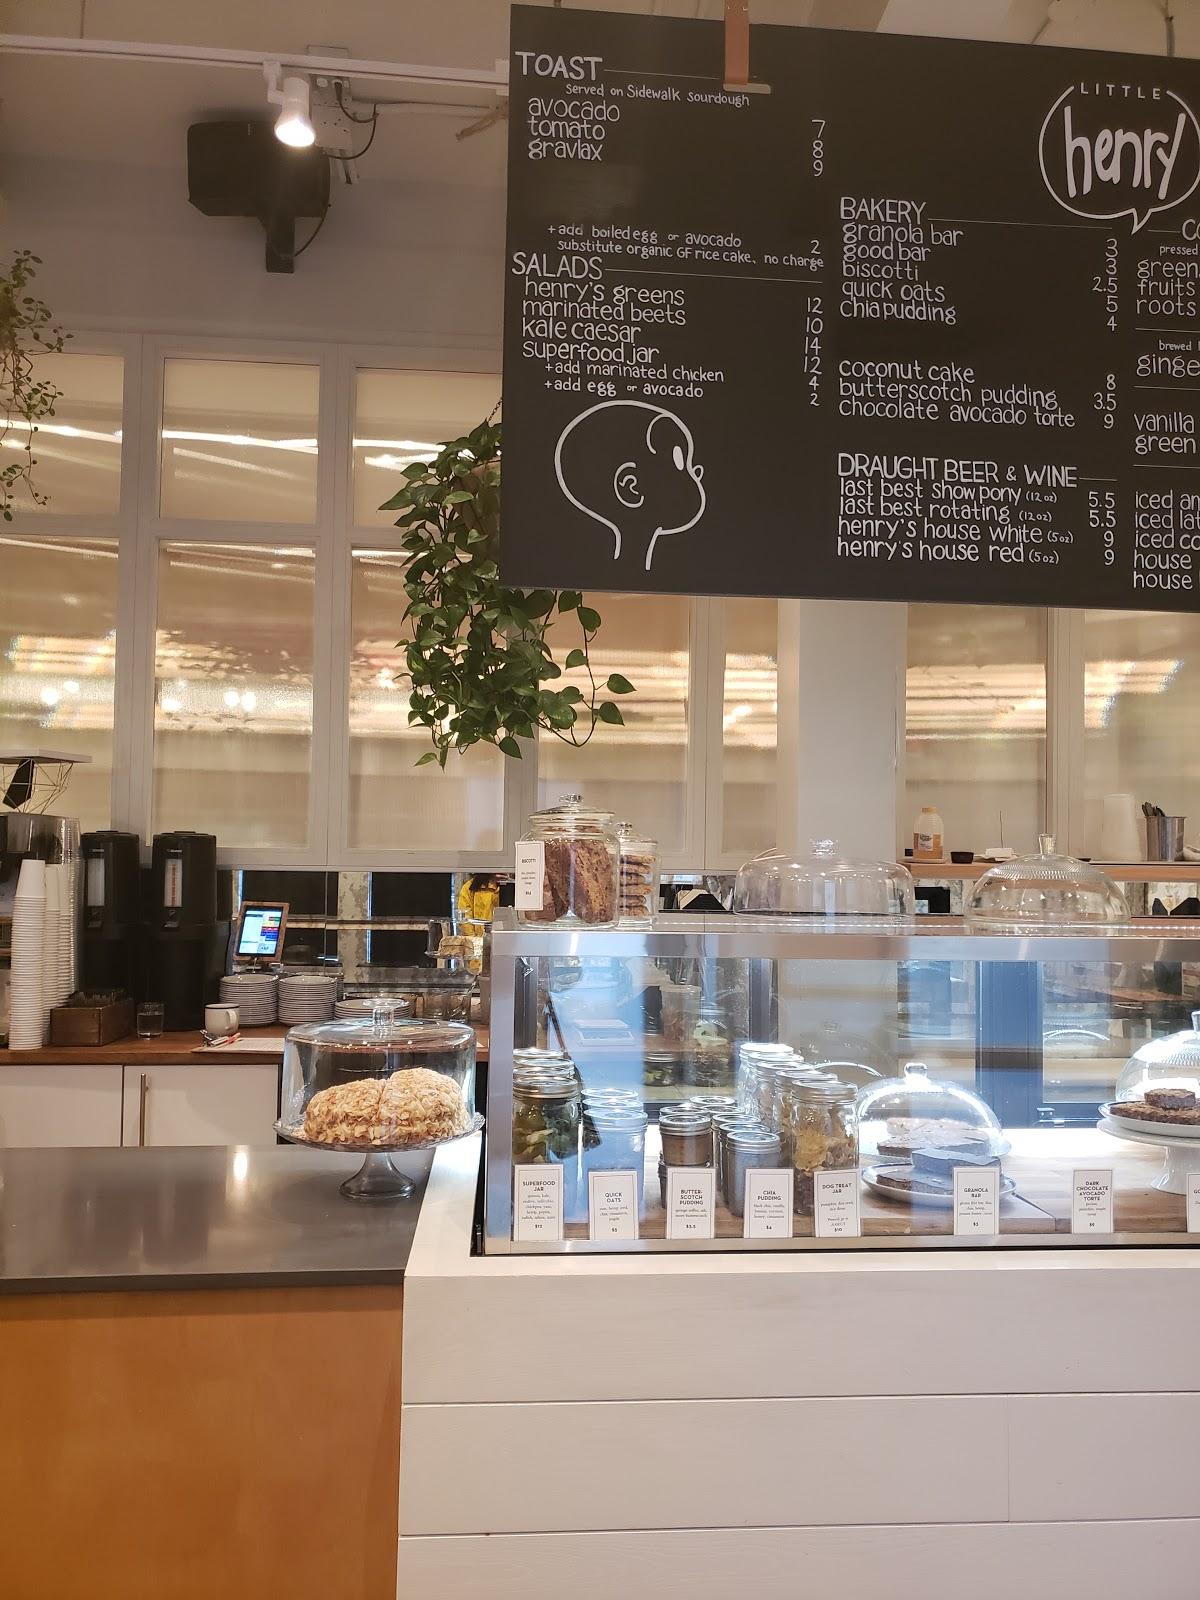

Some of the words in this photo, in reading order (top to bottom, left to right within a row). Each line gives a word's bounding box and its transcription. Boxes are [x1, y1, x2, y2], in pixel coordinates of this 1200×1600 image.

[515, 51, 603, 80] TOAST
[566, 84, 604, 97] Served
[610, 87, 624, 96] on
[627, 84, 681, 101] Sidewalk
[687, 91, 750, 108] sourdough
[1080, 82, 1161, 100] LITTLE
[528, 97, 620, 121] avocado
[528, 116, 606, 140] tomato
[811, 119, 826, 138] 7
[528, 138, 603, 161] gravlax
[812, 140, 824, 158] 8
[1064, 105, 1187, 200] henry
[813, 159, 823, 176] 9
[840, 196, 927, 224] BAKERY
[592, 225, 630, 240] boiled
[632, 230, 658, 244] egg
[667, 233, 680, 241] or
[685, 232, 742, 248] avocado
[842, 221, 924, 244] granola
[930, 223, 964, 246] bar
[557, 239, 623, 254] substitute
[627, 244, 673, 260] organic
[677, 247, 692, 259] GF
[695, 248, 720, 261] rice
[764, 255, 779, 265] no
[783, 254, 824, 272] charge
[810, 239, 821, 254] 2
[843, 241, 894, 262] good
[898, 243, 931, 261] bar
[1105, 238, 1118, 257] 3
[1160, 243, 1199, 256] pressed
[511, 251, 603, 280] SALADS
[842, 260, 919, 281] biscotti
[1105, 258, 1117, 275] 3
[525, 275, 605, 302] henry's
[613, 285, 685, 306] greens
[842, 279, 893, 301] quick
[901, 281, 945, 302] oats
[1092, 276, 1118, 293] 2.5
[1137, 278, 1195, 296] fruits
[522, 299, 624, 321] marinated
[630, 302, 686, 326] beets
[807, 297, 823, 314] 12
[840, 296, 880, 318] chia
[883, 300, 956, 325] pudding
[1106, 295, 1118, 312] 5
[1136, 296, 1196, 316] roots
[522, 317, 567, 339] kale
[571, 322, 641, 343] caesar
[806, 317, 824, 334] 10
[1106, 315, 1117, 331] 4
[522, 340, 624, 362] superfood
[626, 343, 660, 365] jar
[804, 336, 822, 355] 14
[1159, 340, 1192, 351] brewed
[586, 363, 667, 379] marinated
[672, 365, 724, 382] chicken
[804, 356, 822, 374] 12
[839, 360, 923, 380] coconut
[928, 362, 975, 383] cake
[587, 381, 617, 397] egg
[643, 383, 704, 398] avocado
[808, 376, 819, 390] 4
[1106, 373, 1116, 390] 8
[809, 392, 820, 406] 2
[839, 377, 972, 402] butterscotch
[981, 384, 1058, 410] pudding
[1093, 392, 1117, 411] 3.5
[839, 395, 939, 420] chocolate
[950, 404, 1026, 424] avocado
[1034, 406, 1075, 427] torte
[1103, 413, 1114, 429] 9
[1133, 411, 1195, 433] vanilla
[1135, 434, 1196, 455] green
[838, 453, 939, 480] DRAUGHT
[944, 459, 999, 483] BEER
[1006, 465, 1017, 482] &
[1023, 464, 1077, 487] WINE
[840, 477, 873, 496] last
[880, 478, 923, 498] best
[1088, 491, 1115, 509] 5.5
[1135, 489, 1173, 509] iced
[840, 496, 874, 516] last
[880, 496, 923, 517] best
[929, 499, 1011, 524] rotating
[1089, 509, 1117, 528] 5.5
[1135, 509, 1173, 529] iced
[838, 515, 917, 539] henry's
[924, 517, 981, 541] house
[988, 524, 1043, 543] white
[1103, 530, 1114, 547] 9
[1135, 528, 1174, 549] iced
[837, 537, 913, 560] henry's
[920, 540, 979, 561] house
[988, 542, 1024, 562] red
[1104, 549, 1115, 565] 9
[1133, 549, 1192, 569] house
[1133, 570, 1193, 590] house
